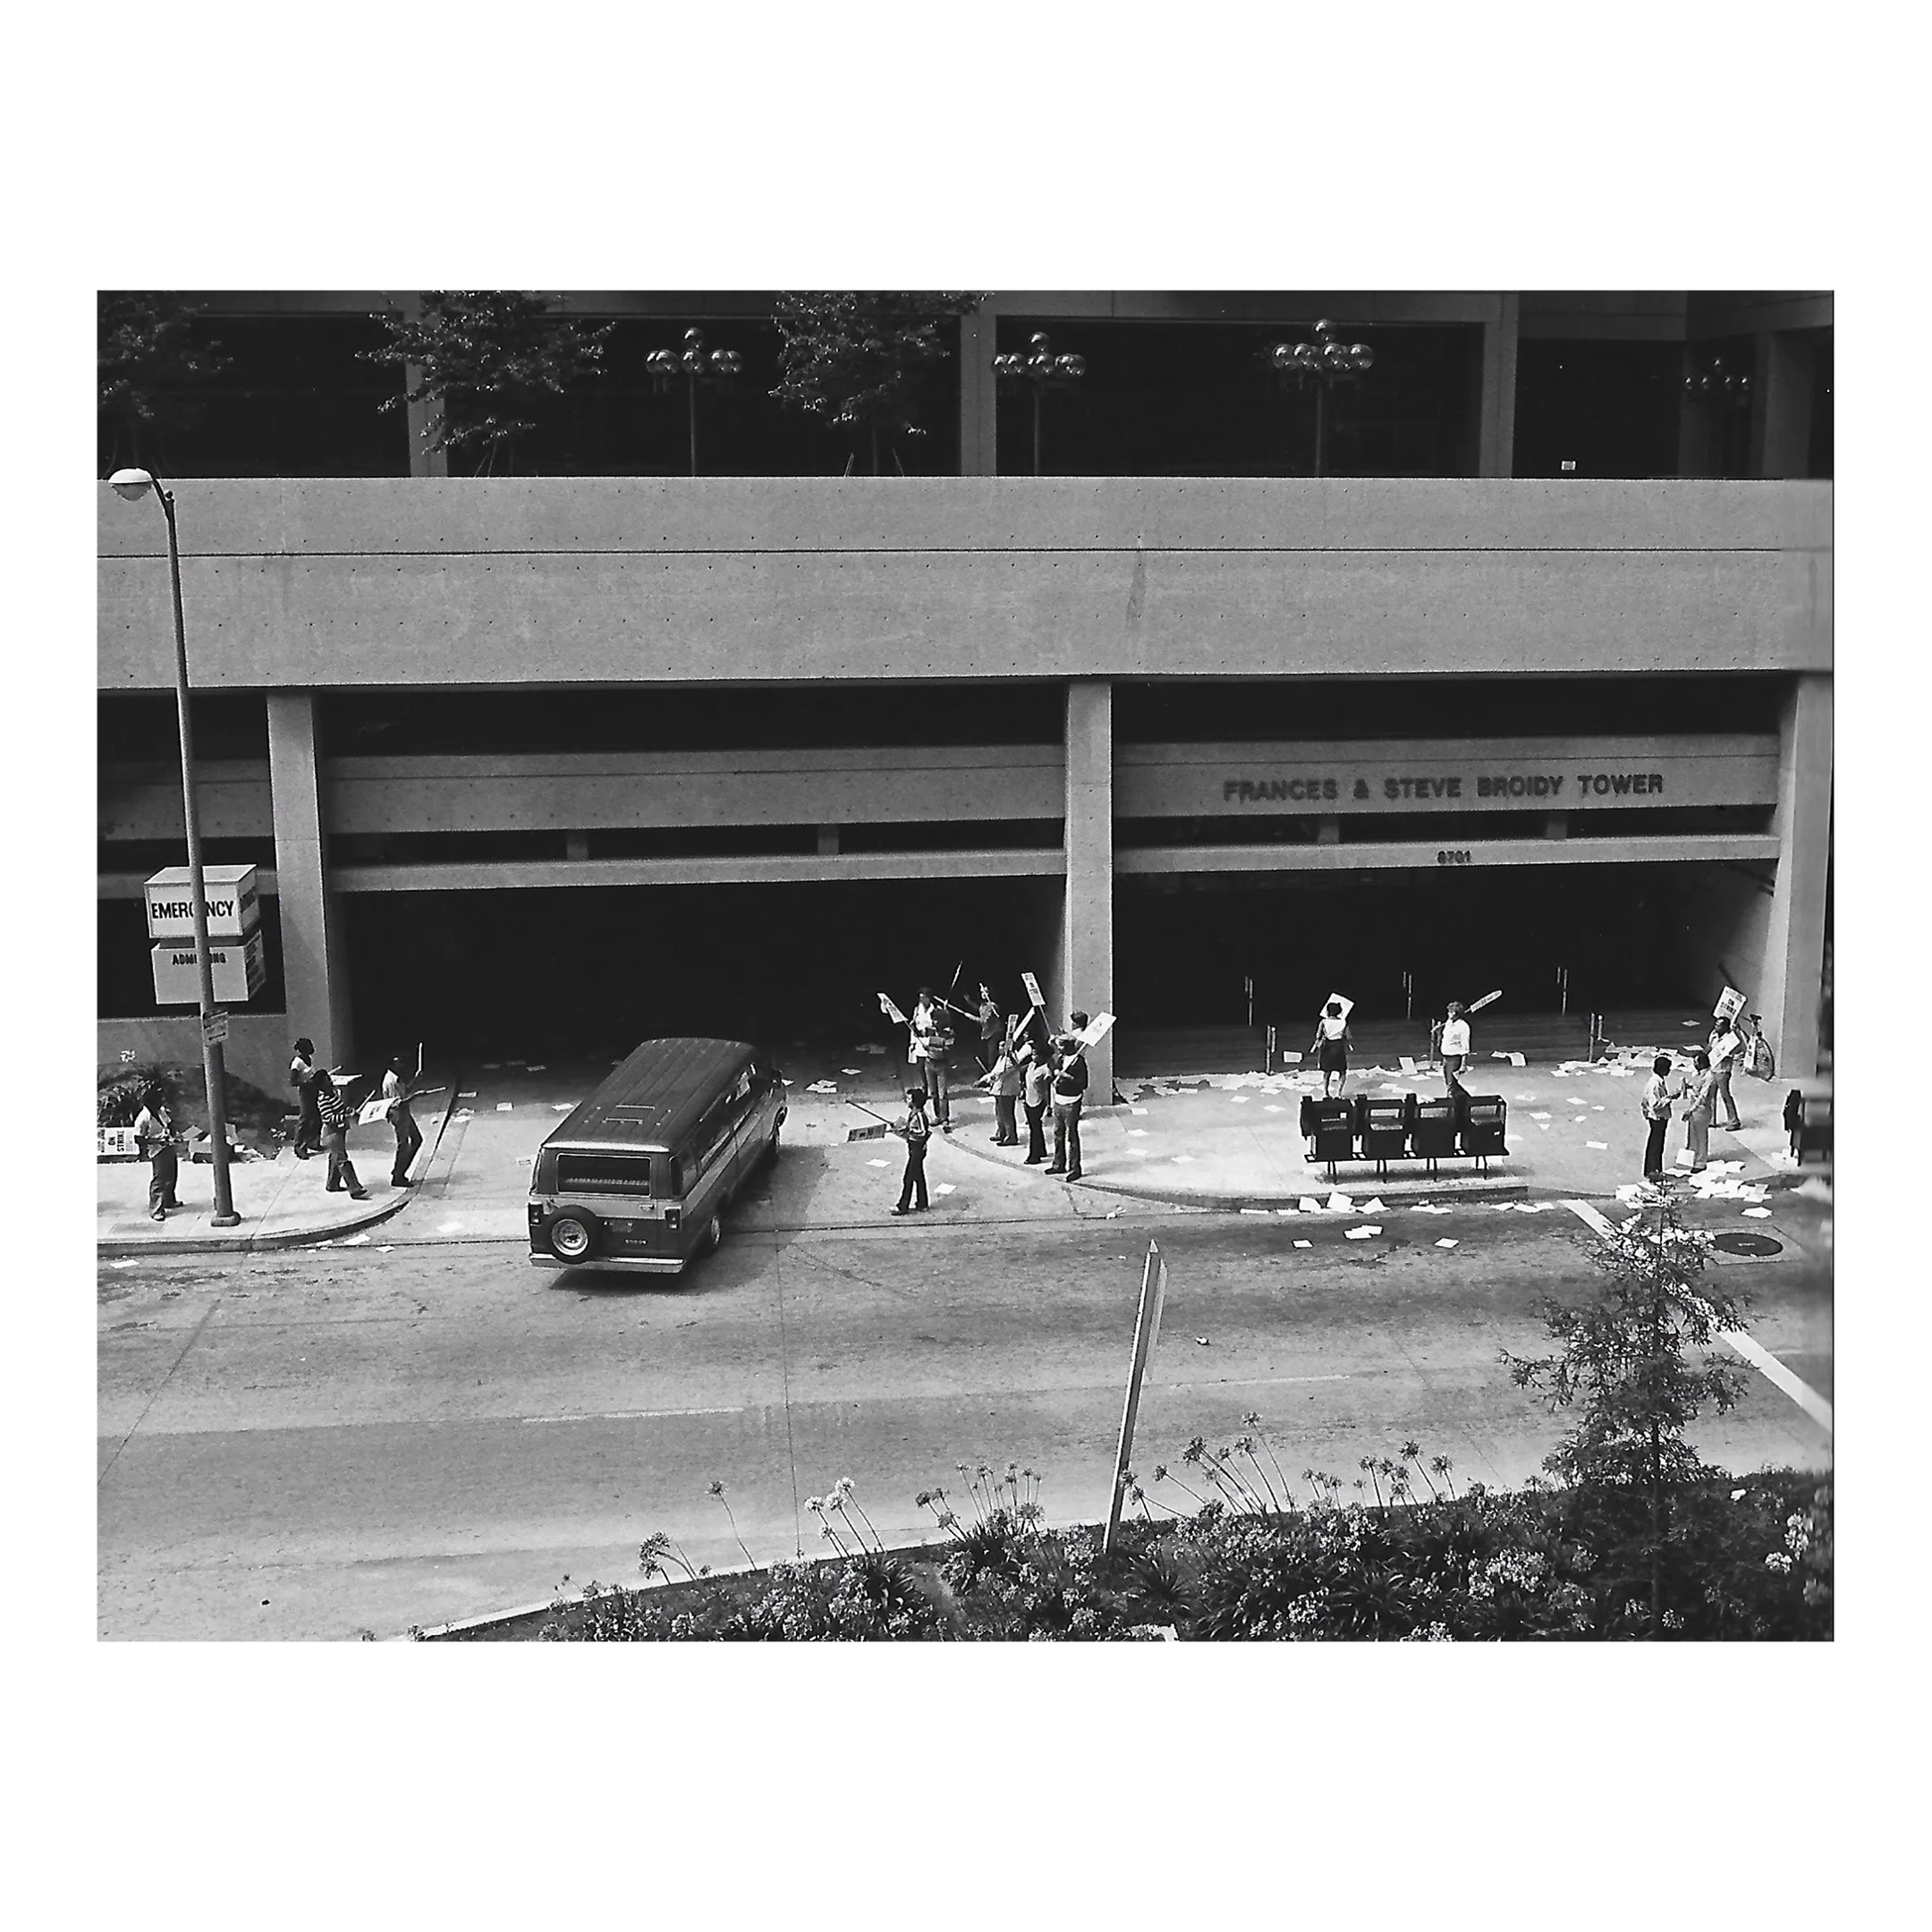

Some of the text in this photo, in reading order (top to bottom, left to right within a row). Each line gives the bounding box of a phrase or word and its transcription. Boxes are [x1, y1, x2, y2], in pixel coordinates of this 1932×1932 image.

[1223, 774, 1664, 801] FRANCES & STEVE BROIDY TOWER
[108, 1136, 116, 1146] ON
[117, 1130, 125, 1152] STRIKE
